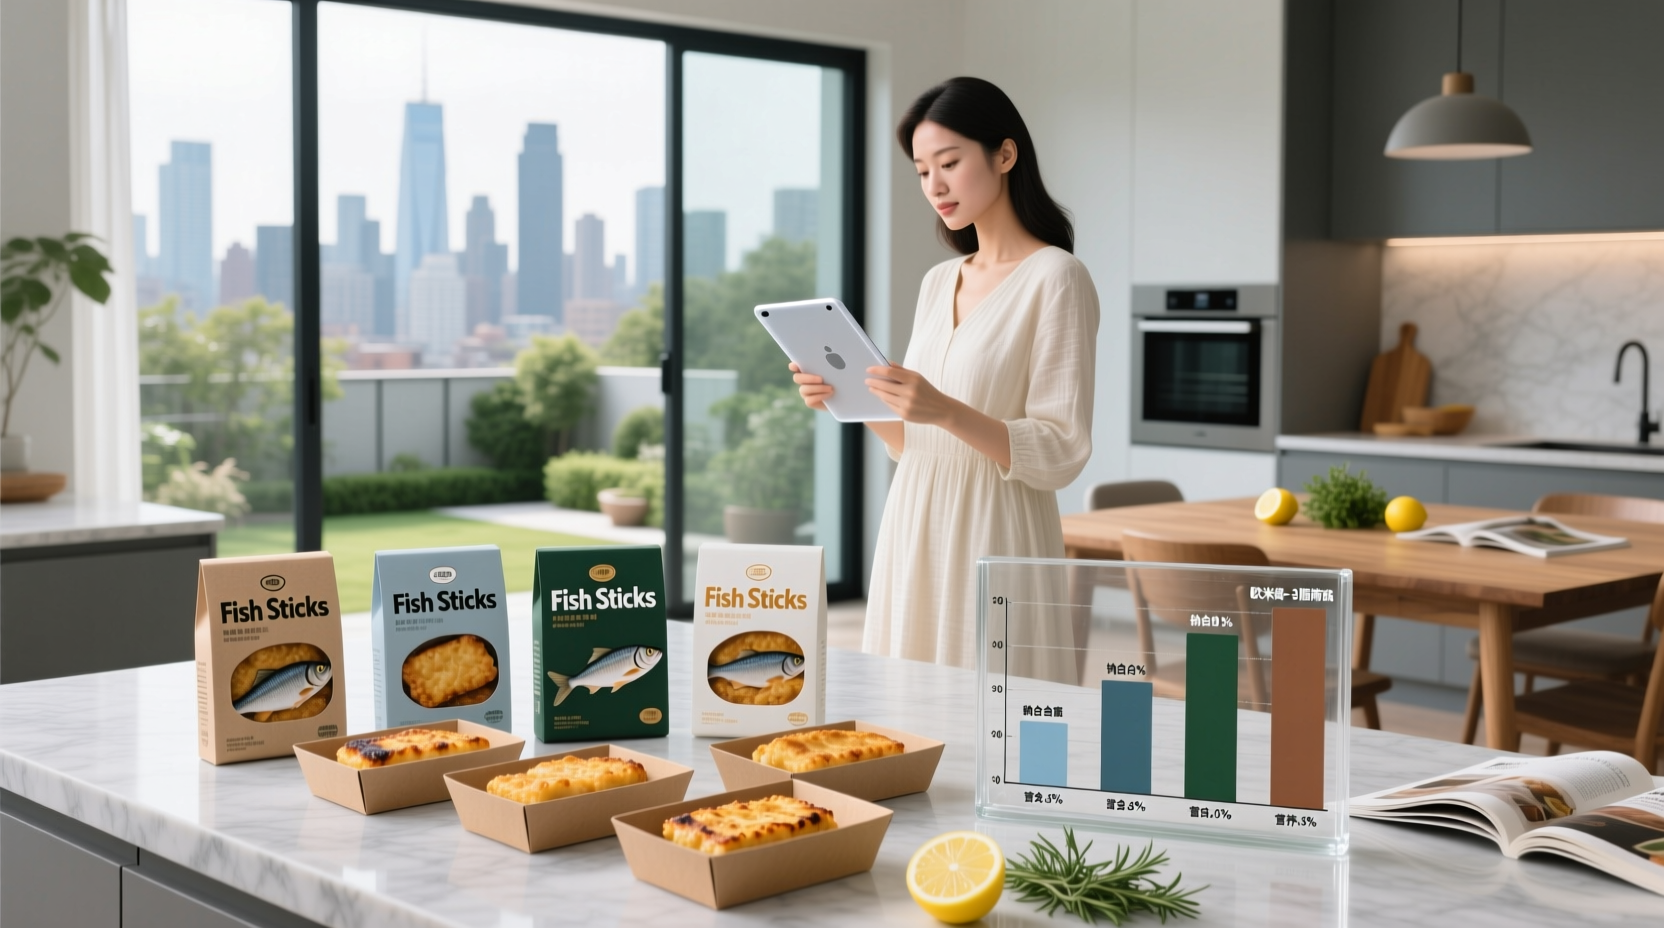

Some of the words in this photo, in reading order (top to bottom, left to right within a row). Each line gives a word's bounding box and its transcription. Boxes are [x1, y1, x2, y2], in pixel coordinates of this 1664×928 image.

[220, 599, 263, 624] Fish
[266, 595, 330, 620] Sticks
[393, 591, 434, 614] Fish
[436, 588, 497, 611] Sticks
[551, 588, 593, 612] Fish
[595, 585, 657, 610] Sticks
[704, 586, 744, 608] Fish
[747, 587, 808, 610] Sticks
